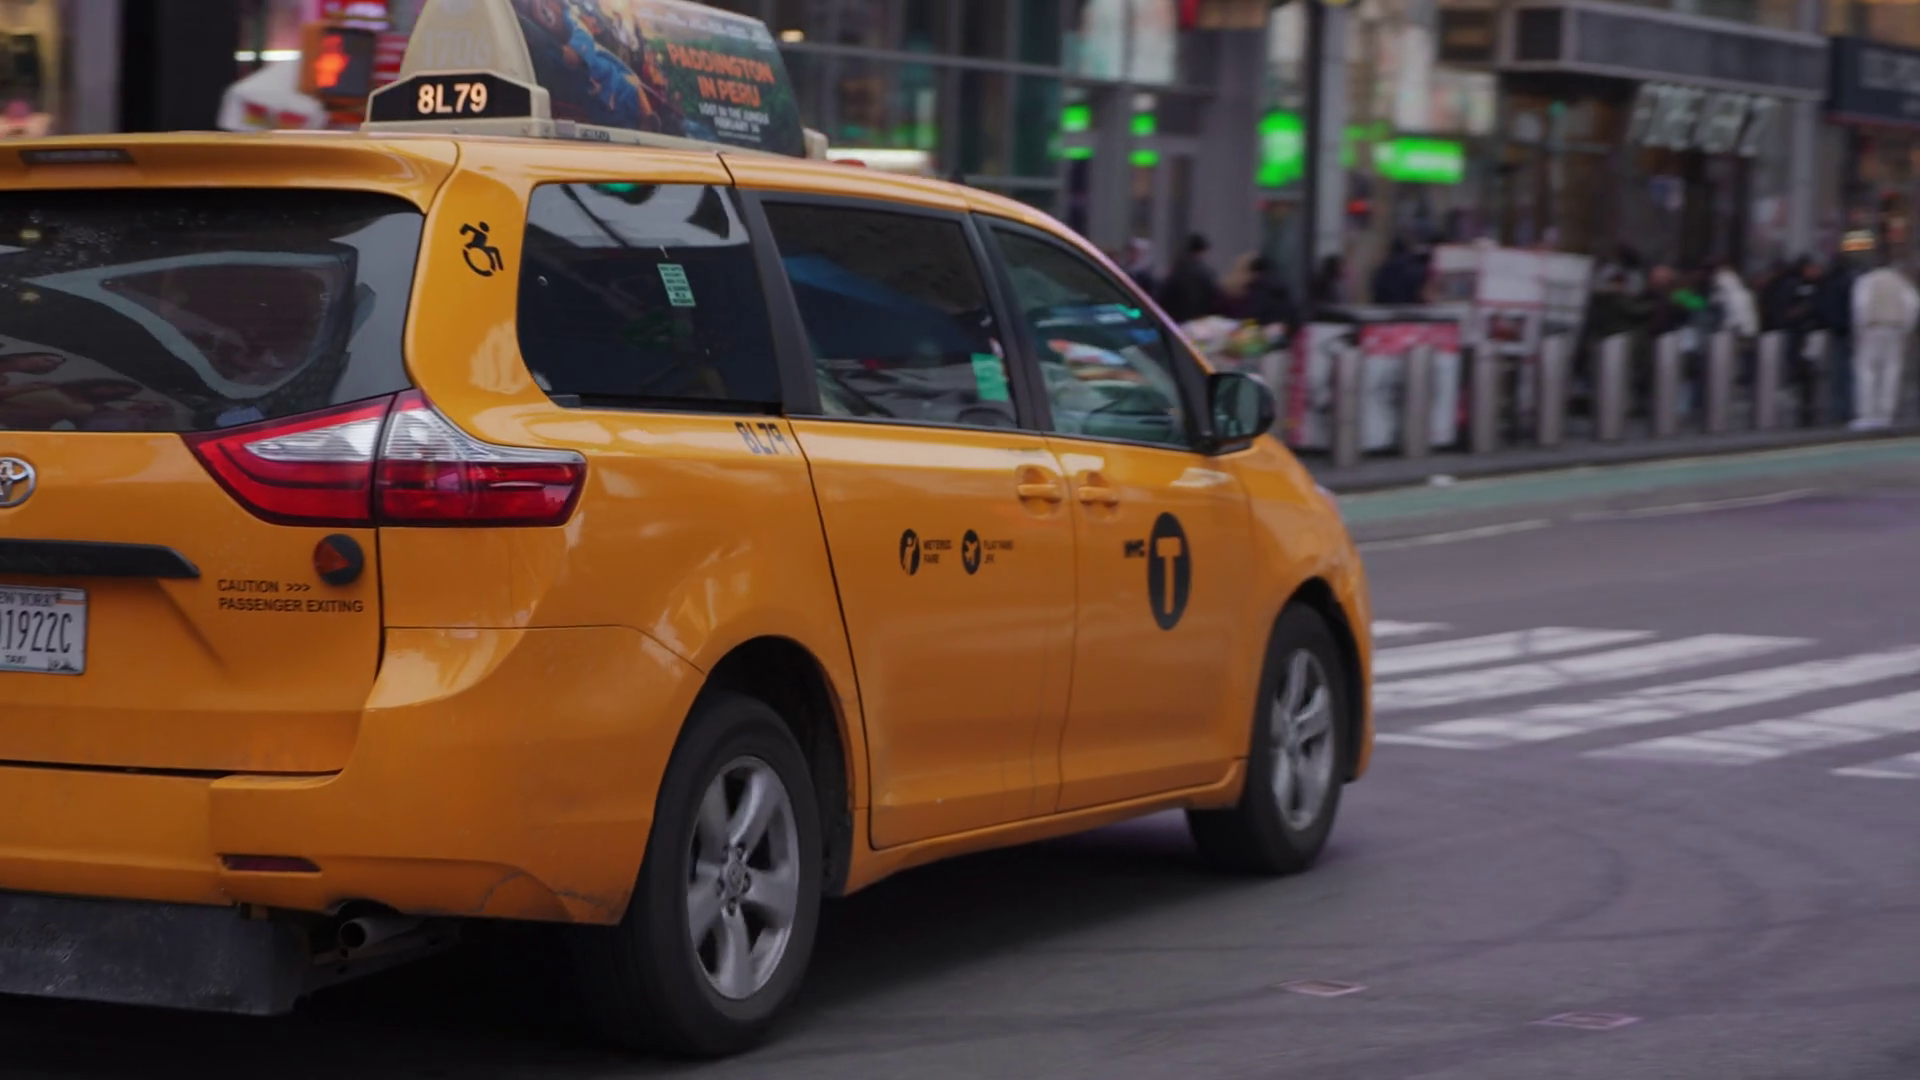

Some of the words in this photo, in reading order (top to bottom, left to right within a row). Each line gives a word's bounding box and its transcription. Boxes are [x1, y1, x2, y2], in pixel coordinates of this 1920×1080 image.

[666, 43, 775, 84] PADDINGTON
[417, 82, 488, 114] 8L79
[697, 75, 718, 99] IN
[717, 79, 761, 108] PERU
[734, 421, 795, 456] 8L79
[217, 579, 279, 593] CAUTION
[218, 597, 303, 612] PASSENGER
[307, 599, 364, 613] EXITING
[0, 609, 73, 654] 1922C
